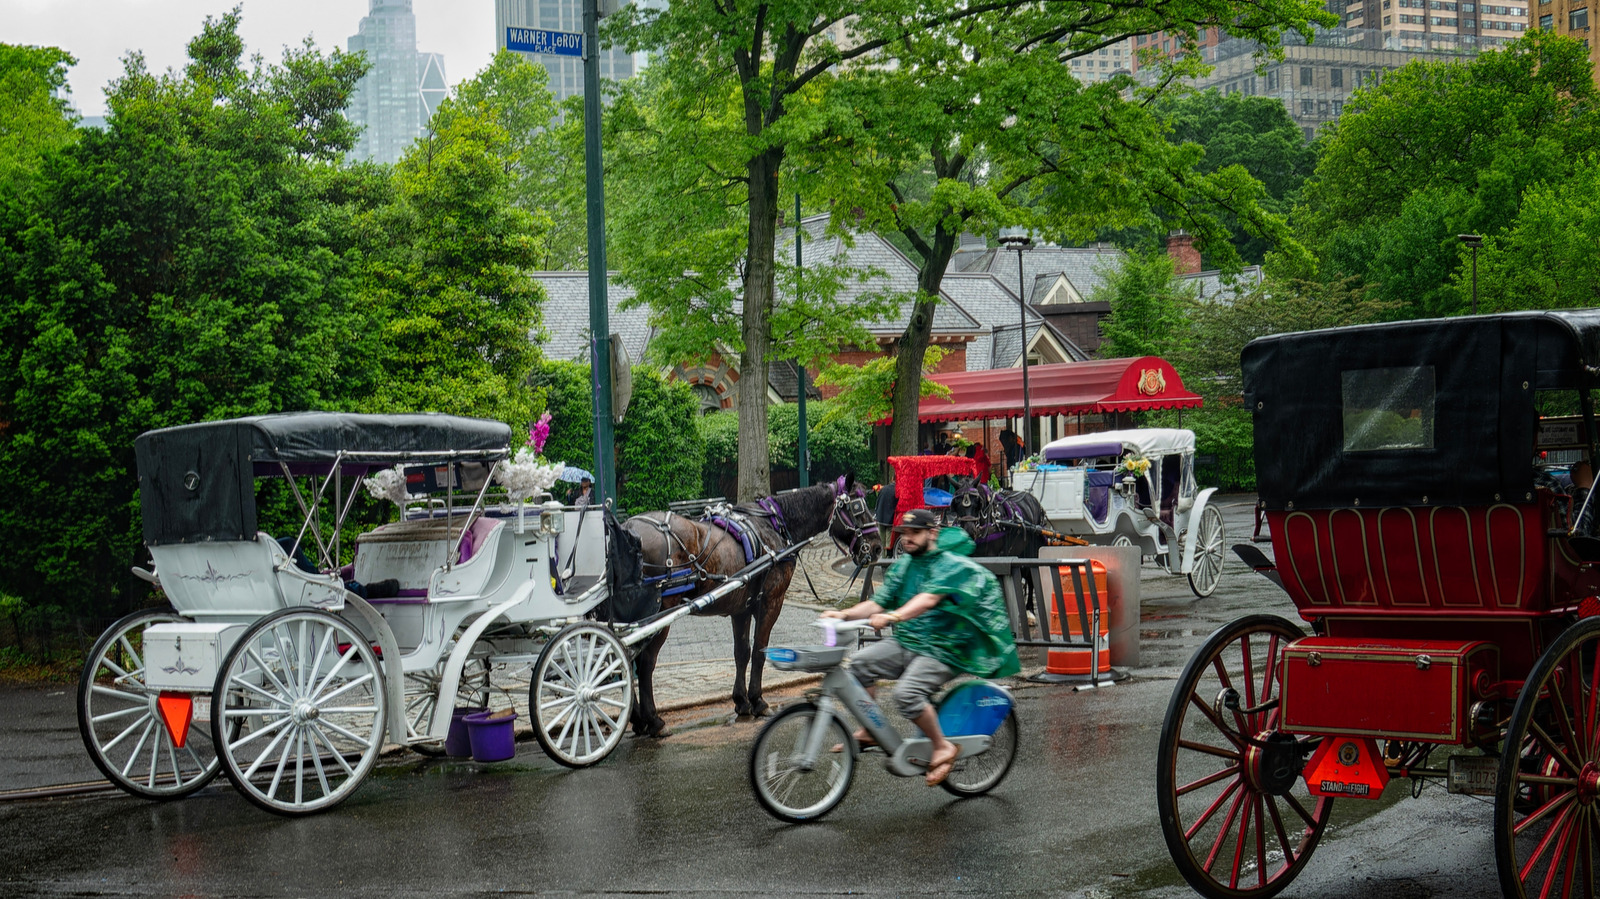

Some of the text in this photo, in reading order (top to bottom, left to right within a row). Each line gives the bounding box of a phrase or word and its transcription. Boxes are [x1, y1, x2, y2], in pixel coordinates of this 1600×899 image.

[510, 28, 581, 49] WARNER LeROY
[534, 45, 557, 54] PLACE
[1468, 770, 1497, 785] 1073
[1321, 781, 1343, 792] STAND
[1350, 783, 1369, 794] FIGHT
